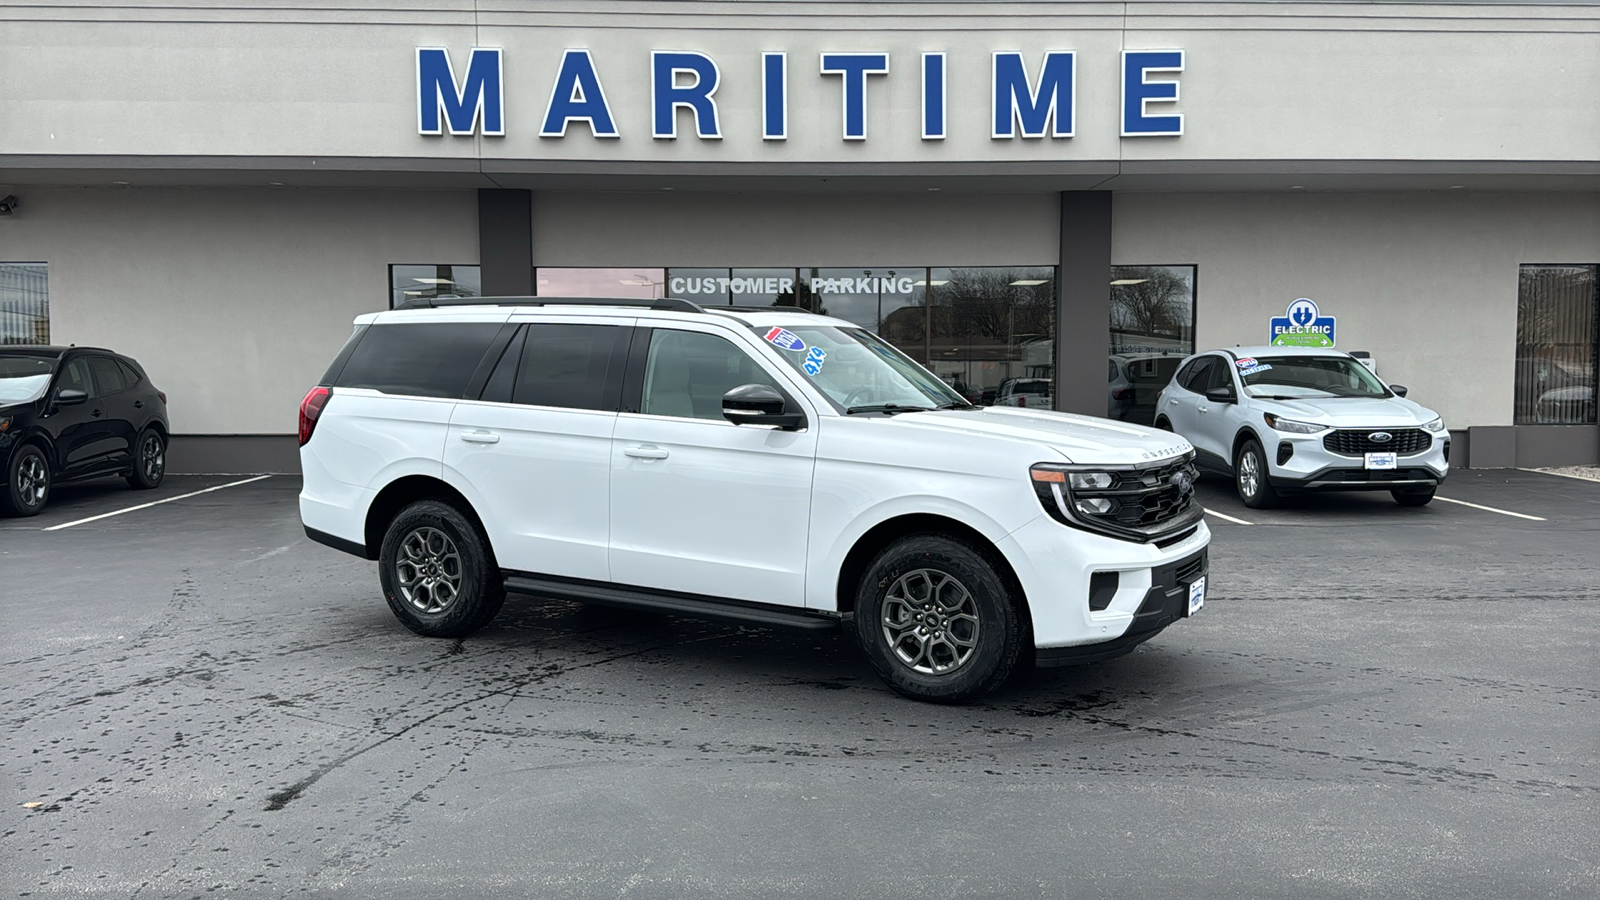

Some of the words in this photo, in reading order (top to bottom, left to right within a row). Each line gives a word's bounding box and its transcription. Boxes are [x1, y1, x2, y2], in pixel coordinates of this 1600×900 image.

[415, 46, 1186, 141] MARITIME
[671, 277, 794, 294] CUSTOMER
[811, 277, 914, 294] PARKING
[1274, 325, 1331, 334] ELECTRIC
